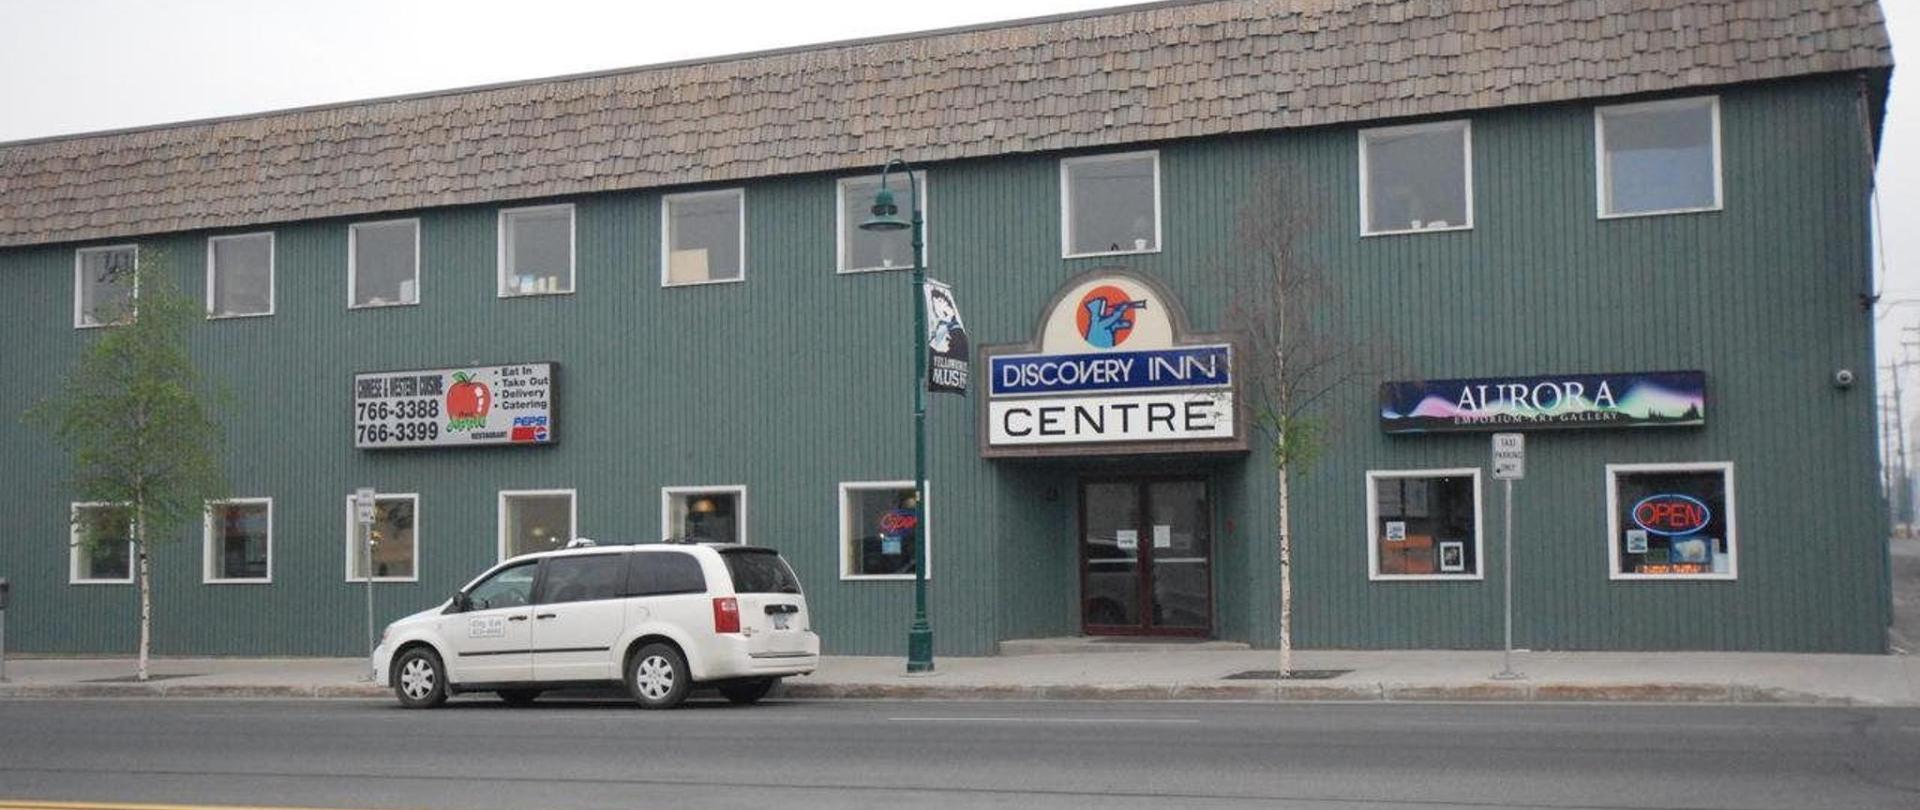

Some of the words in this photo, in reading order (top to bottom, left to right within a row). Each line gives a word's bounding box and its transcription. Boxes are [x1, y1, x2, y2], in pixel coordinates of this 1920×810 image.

[501, 367, 519, 377] Eat
[522, 366, 532, 376] In
[1003, 358, 1134, 388] DISCOVERY
[1149, 354, 1217, 381] INN
[502, 378, 526, 388] Take
[529, 376, 549, 386] Out
[502, 389, 545, 399] Delivery
[1456, 380, 1618, 412] AURORA
[357, 399, 439, 422] 766-3388
[502, 401, 547, 410] Catering
[513, 416, 547, 426] PEPSI
[1003, 400, 1216, 437] CENTRE
[1560, 412, 1618, 422] GALLERY
[357, 421, 439, 443] 766-3399
[1637, 502, 1704, 527] OPEN
